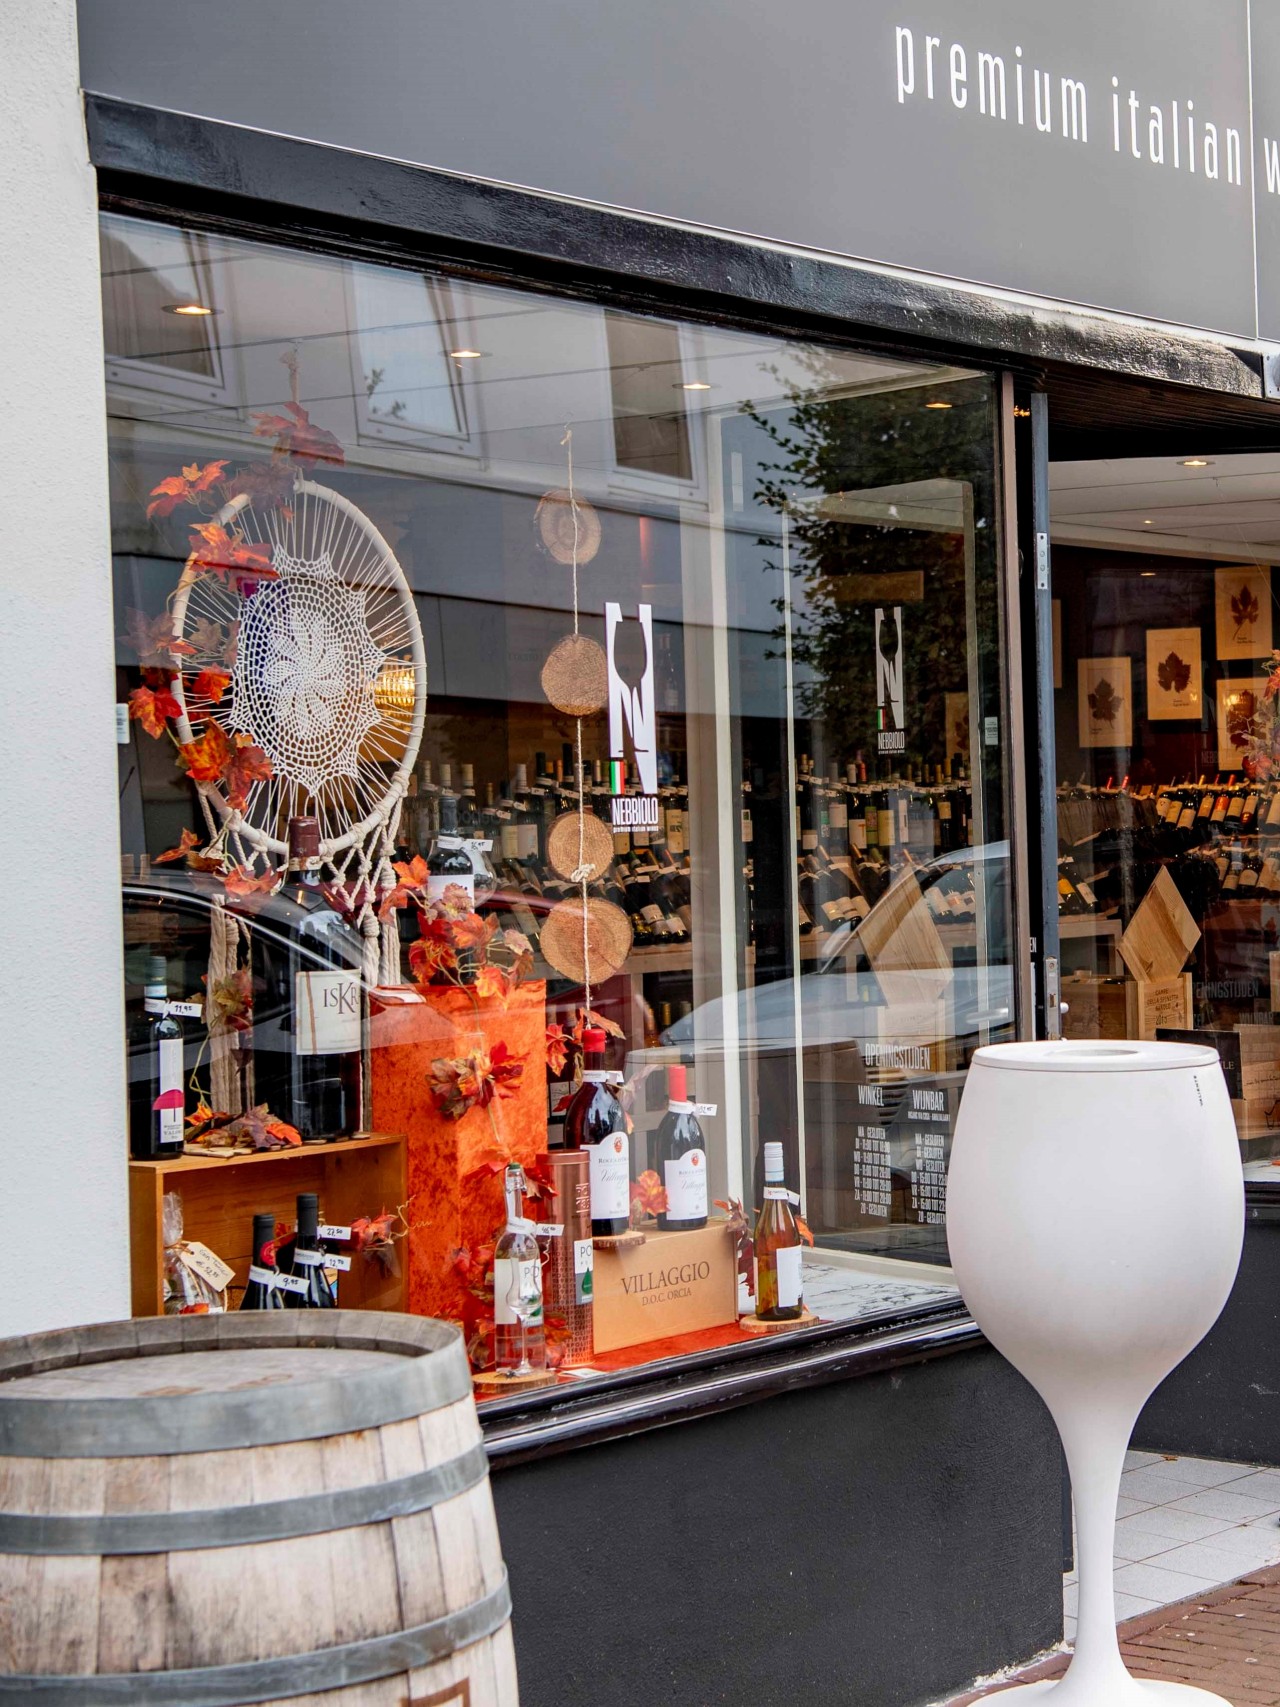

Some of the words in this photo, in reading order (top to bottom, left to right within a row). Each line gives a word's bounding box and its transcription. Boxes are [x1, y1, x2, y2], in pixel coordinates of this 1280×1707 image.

[895, 26, 1088, 143] premium
[1111, 76, 1242, 186] italian
[612, 797, 659, 825] NEBBIOLO
[323, 982, 360, 1014] ISKR
[865, 1043, 931, 1070] OPENINGSTIJDEN
[858, 1085, 884, 1107] WINKEL
[912, 1090, 945, 1111] WIJNBAR
[621, 1261, 710, 1295] VILLAGGIO
[641, 1292, 667, 1307] D.O.C.
[668, 1287, 691, 1302] ORCIA
